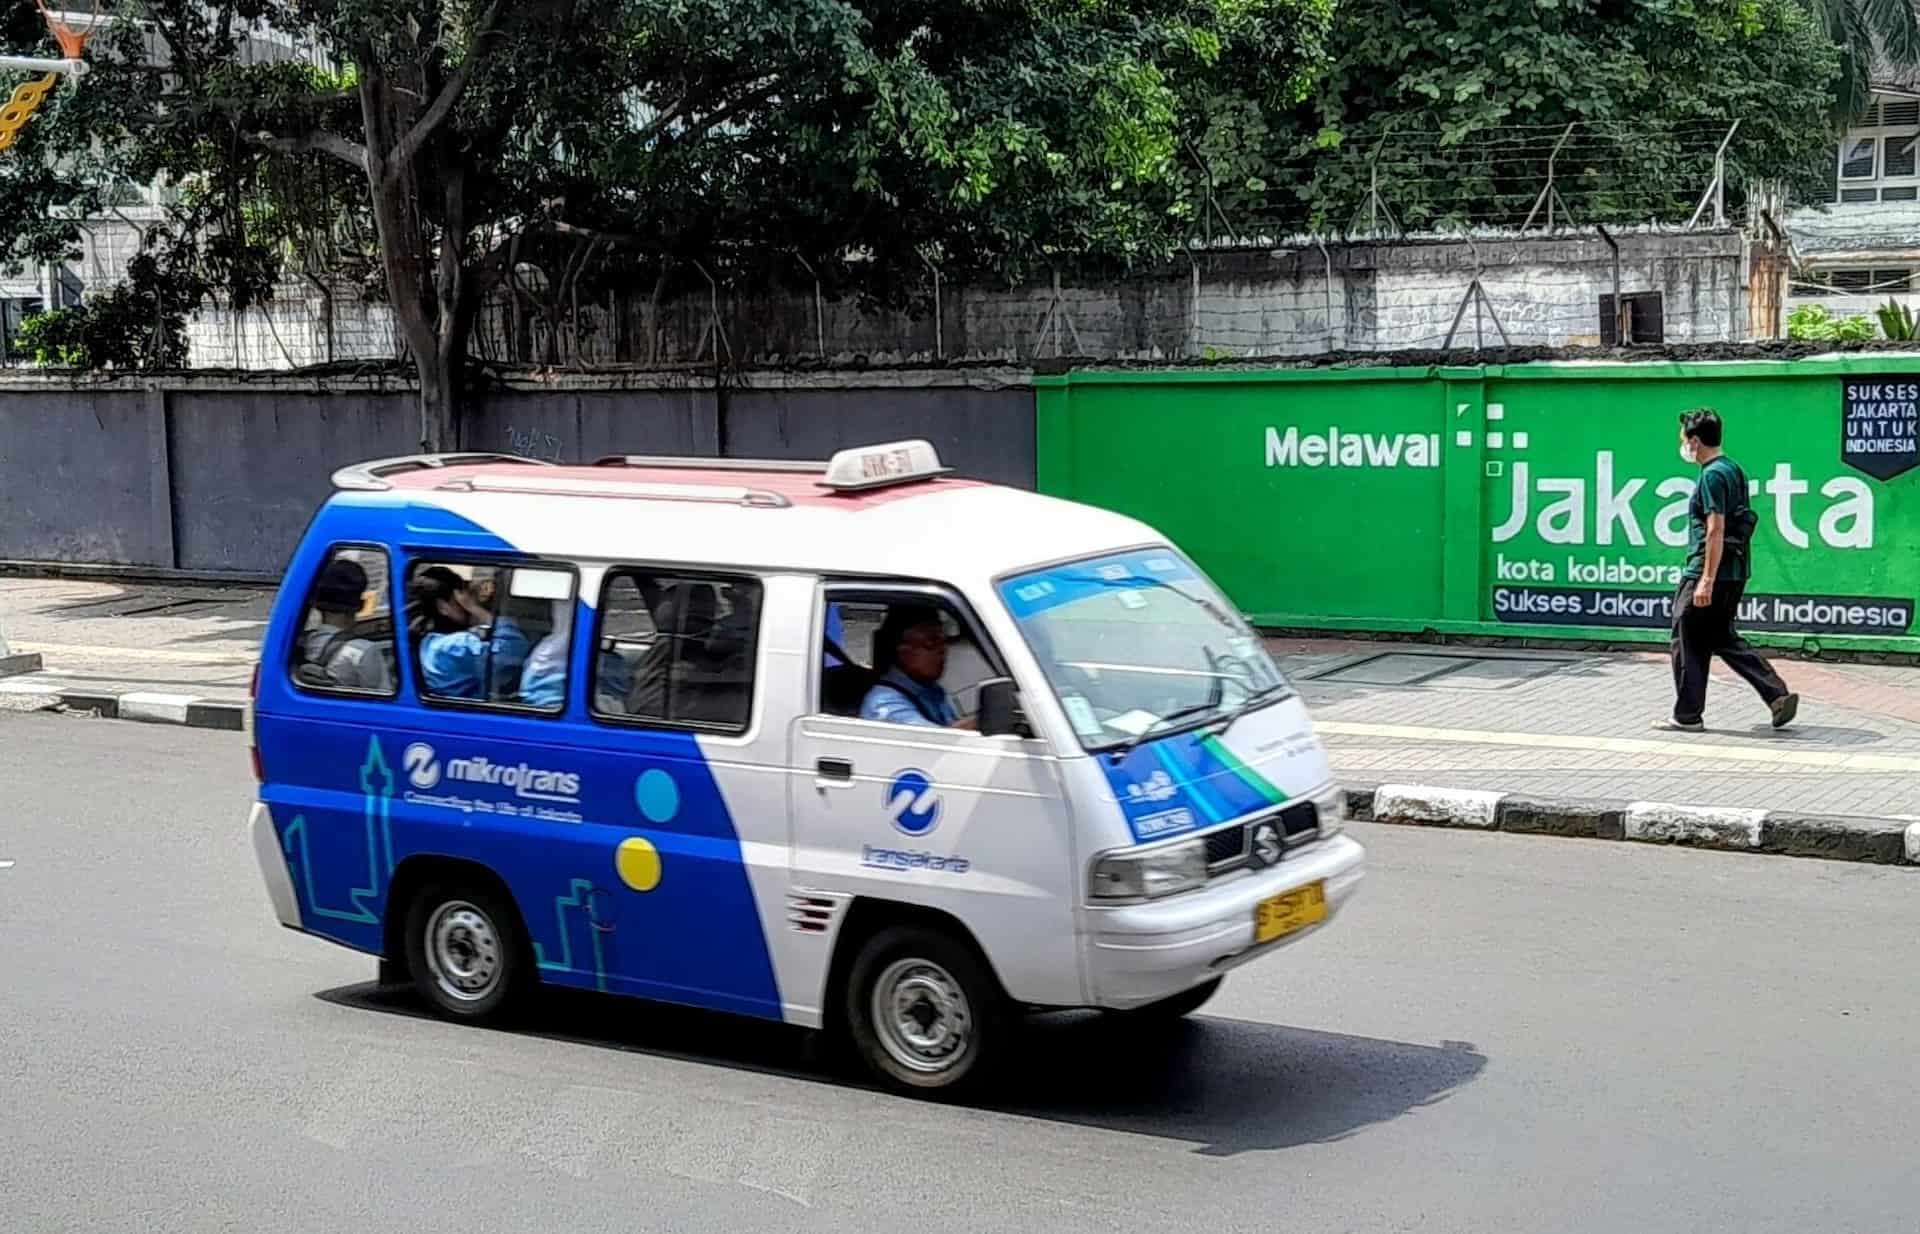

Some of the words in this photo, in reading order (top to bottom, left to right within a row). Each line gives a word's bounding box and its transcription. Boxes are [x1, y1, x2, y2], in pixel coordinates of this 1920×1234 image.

[1847, 384, 1919, 400] SUKSES
[1847, 402, 1918, 418] JAKARTA
[1847, 421, 1917, 437] UNTUK
[1265, 426, 1440, 467] Melawai
[1846, 438, 1916, 453] INDONESIA
[1492, 450, 1874, 549] Jakata
[1497, 553, 1554, 581] kota
[1567, 556, 1684, 584] kolabora
[1495, 588, 1582, 613] Sukses
[1586, 591, 1673, 618] Jakart
[1774, 598, 1907, 626] Indonesia
[447, 756, 581, 803] mikrotrans
